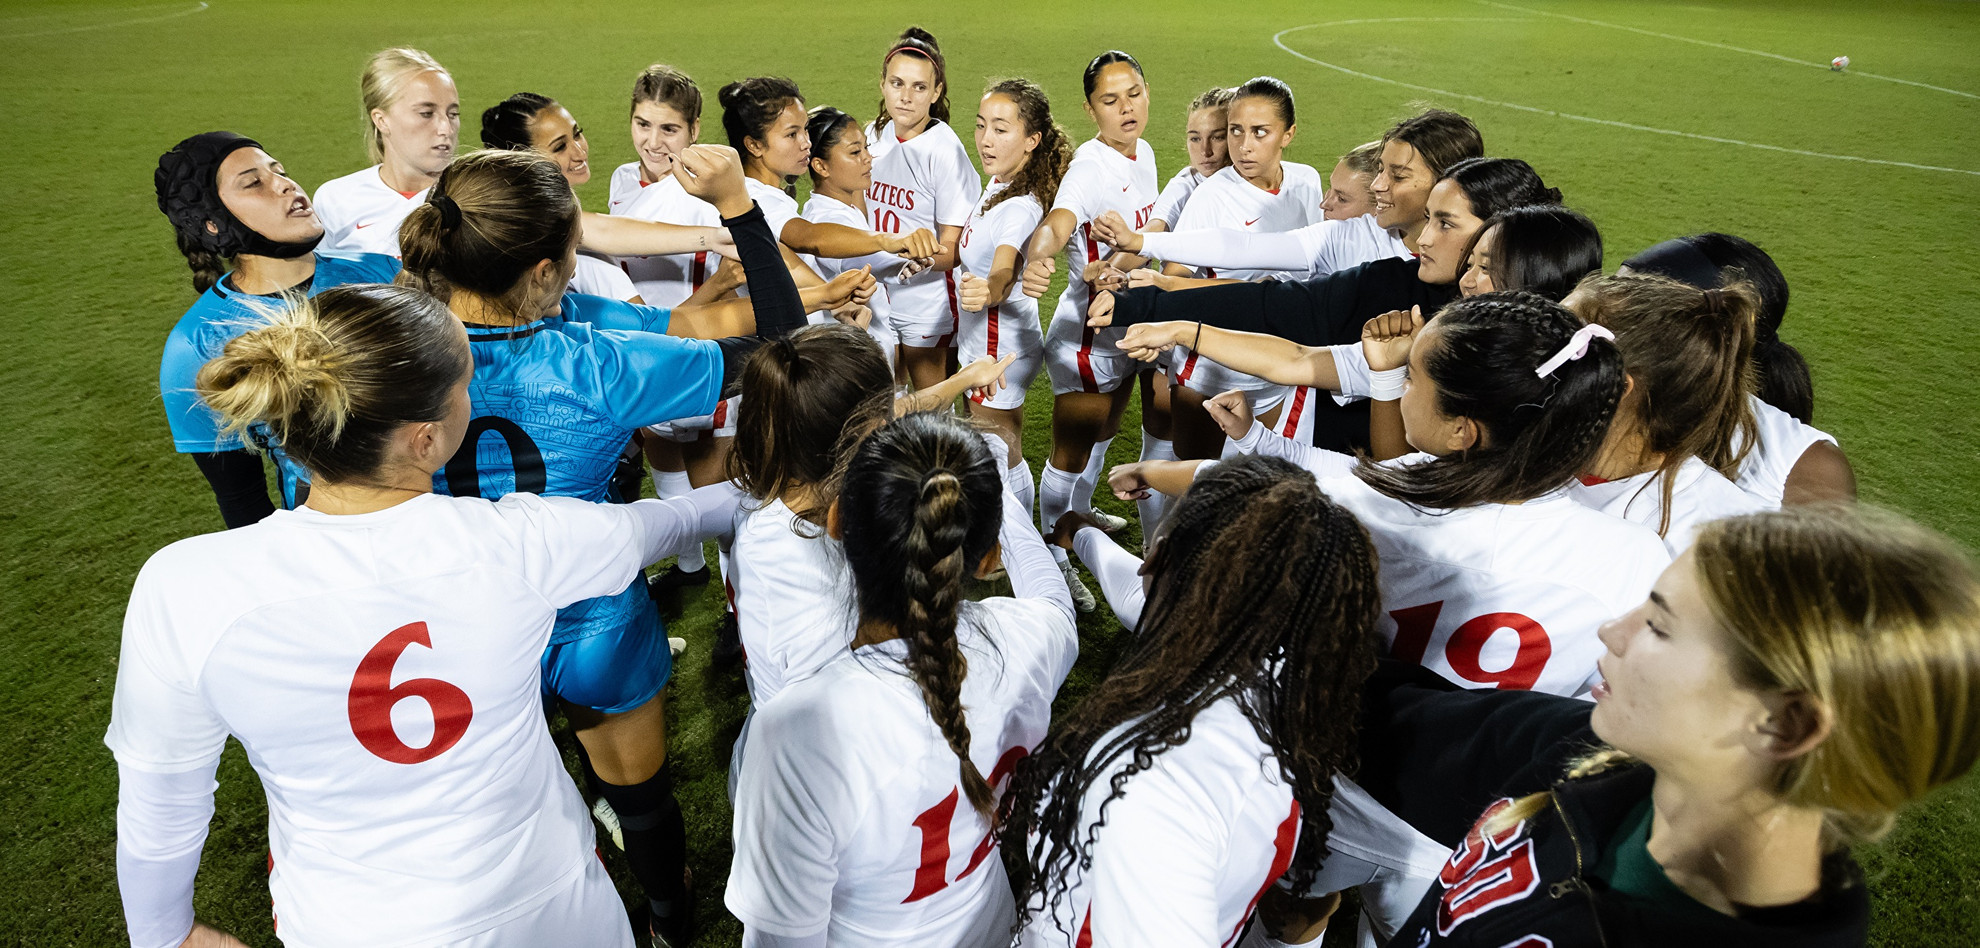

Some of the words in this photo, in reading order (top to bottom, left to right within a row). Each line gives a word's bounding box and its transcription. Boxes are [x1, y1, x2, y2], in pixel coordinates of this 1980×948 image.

[874, 207, 900, 234] 10
[1388, 600, 1552, 691] 19
[347, 621, 474, 765] 6
